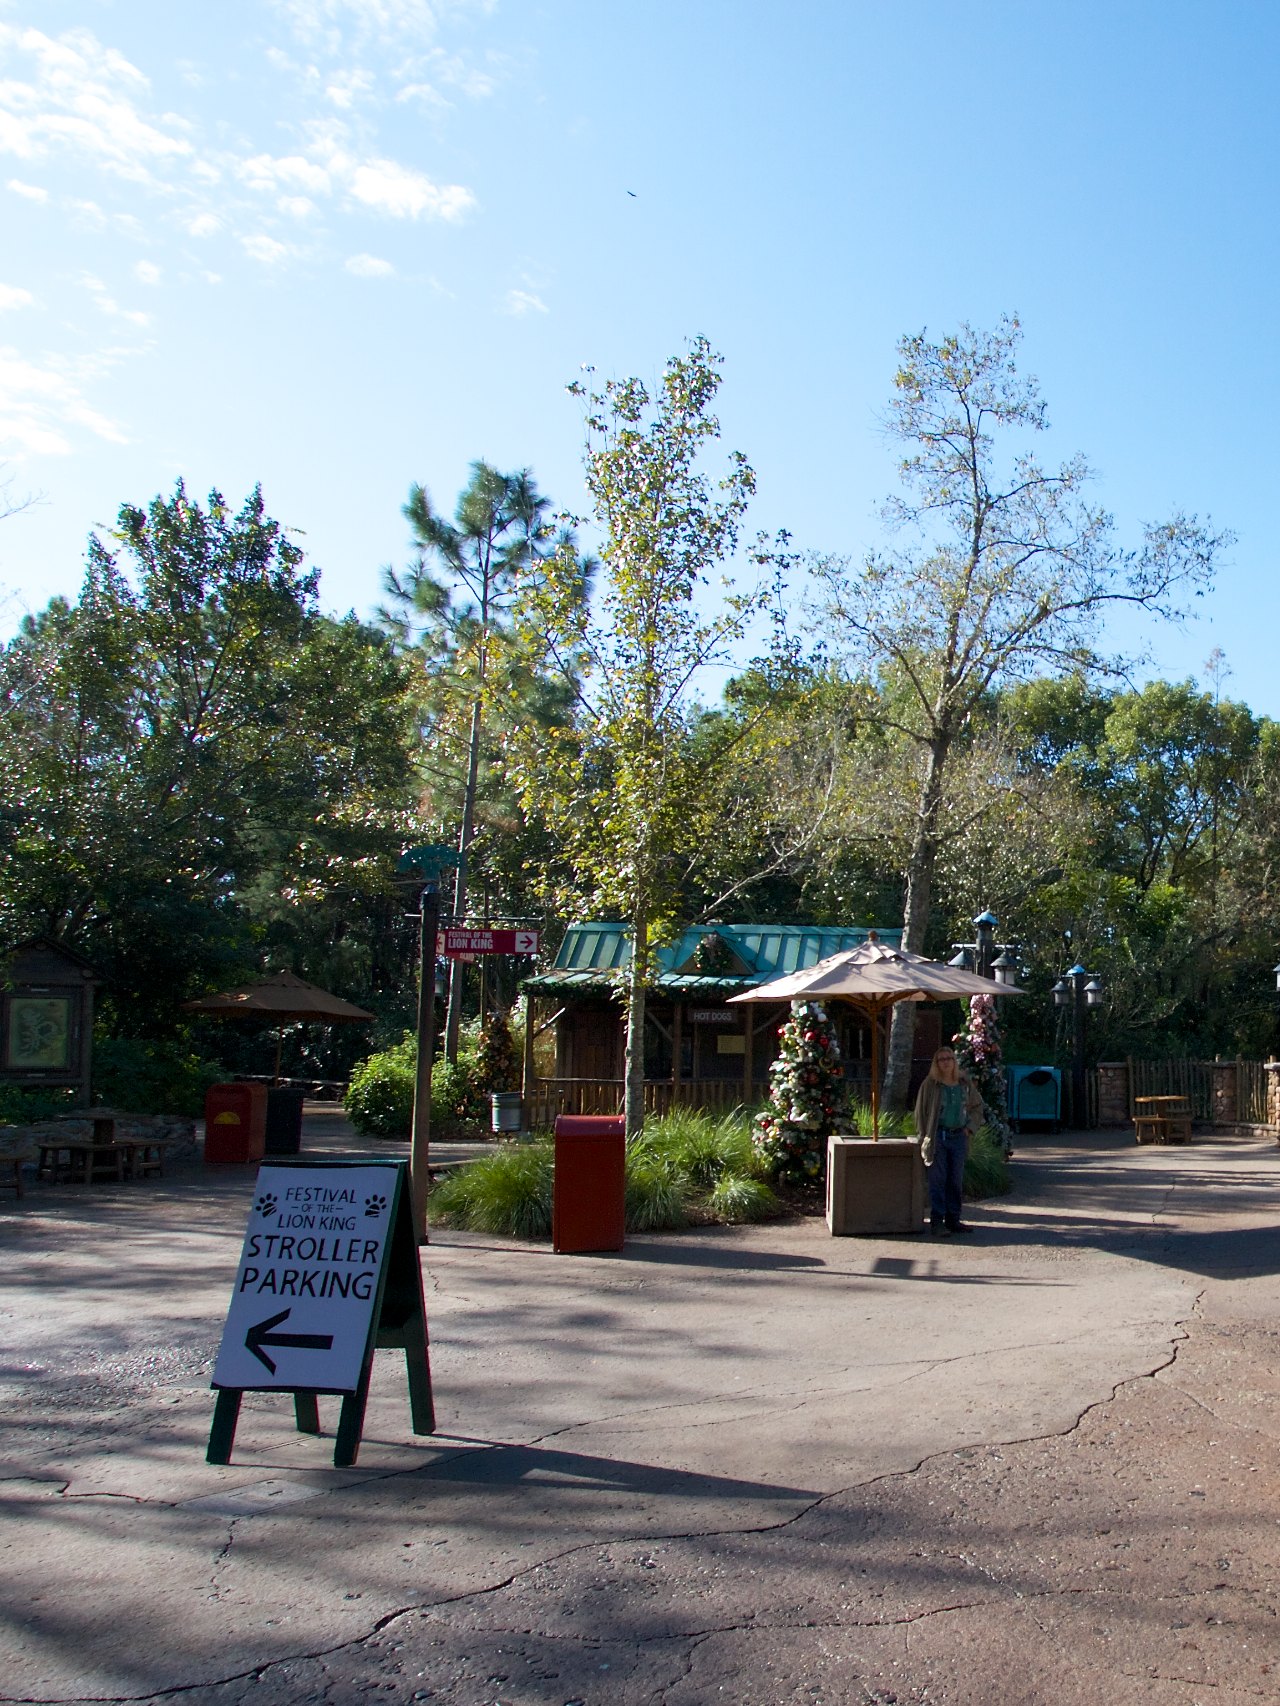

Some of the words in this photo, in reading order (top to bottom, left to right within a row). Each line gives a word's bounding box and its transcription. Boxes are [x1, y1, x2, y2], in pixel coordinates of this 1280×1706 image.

[448, 939, 468, 949] LION
[470, 939, 493, 949] KING
[694, 1012, 710, 1020] HOT
[711, 1012, 732, 1020] DOGS
[285, 1187, 357, 1204] FESTIVAL
[301, 1204, 313, 1213] OF
[317, 1204, 335, 1213] THE
[277, 1214, 315, 1229] LION
[318, 1216, 357, 1231] KING
[248, 1234, 379, 1264] STROLLER
[239, 1267, 375, 1300] PARKING
